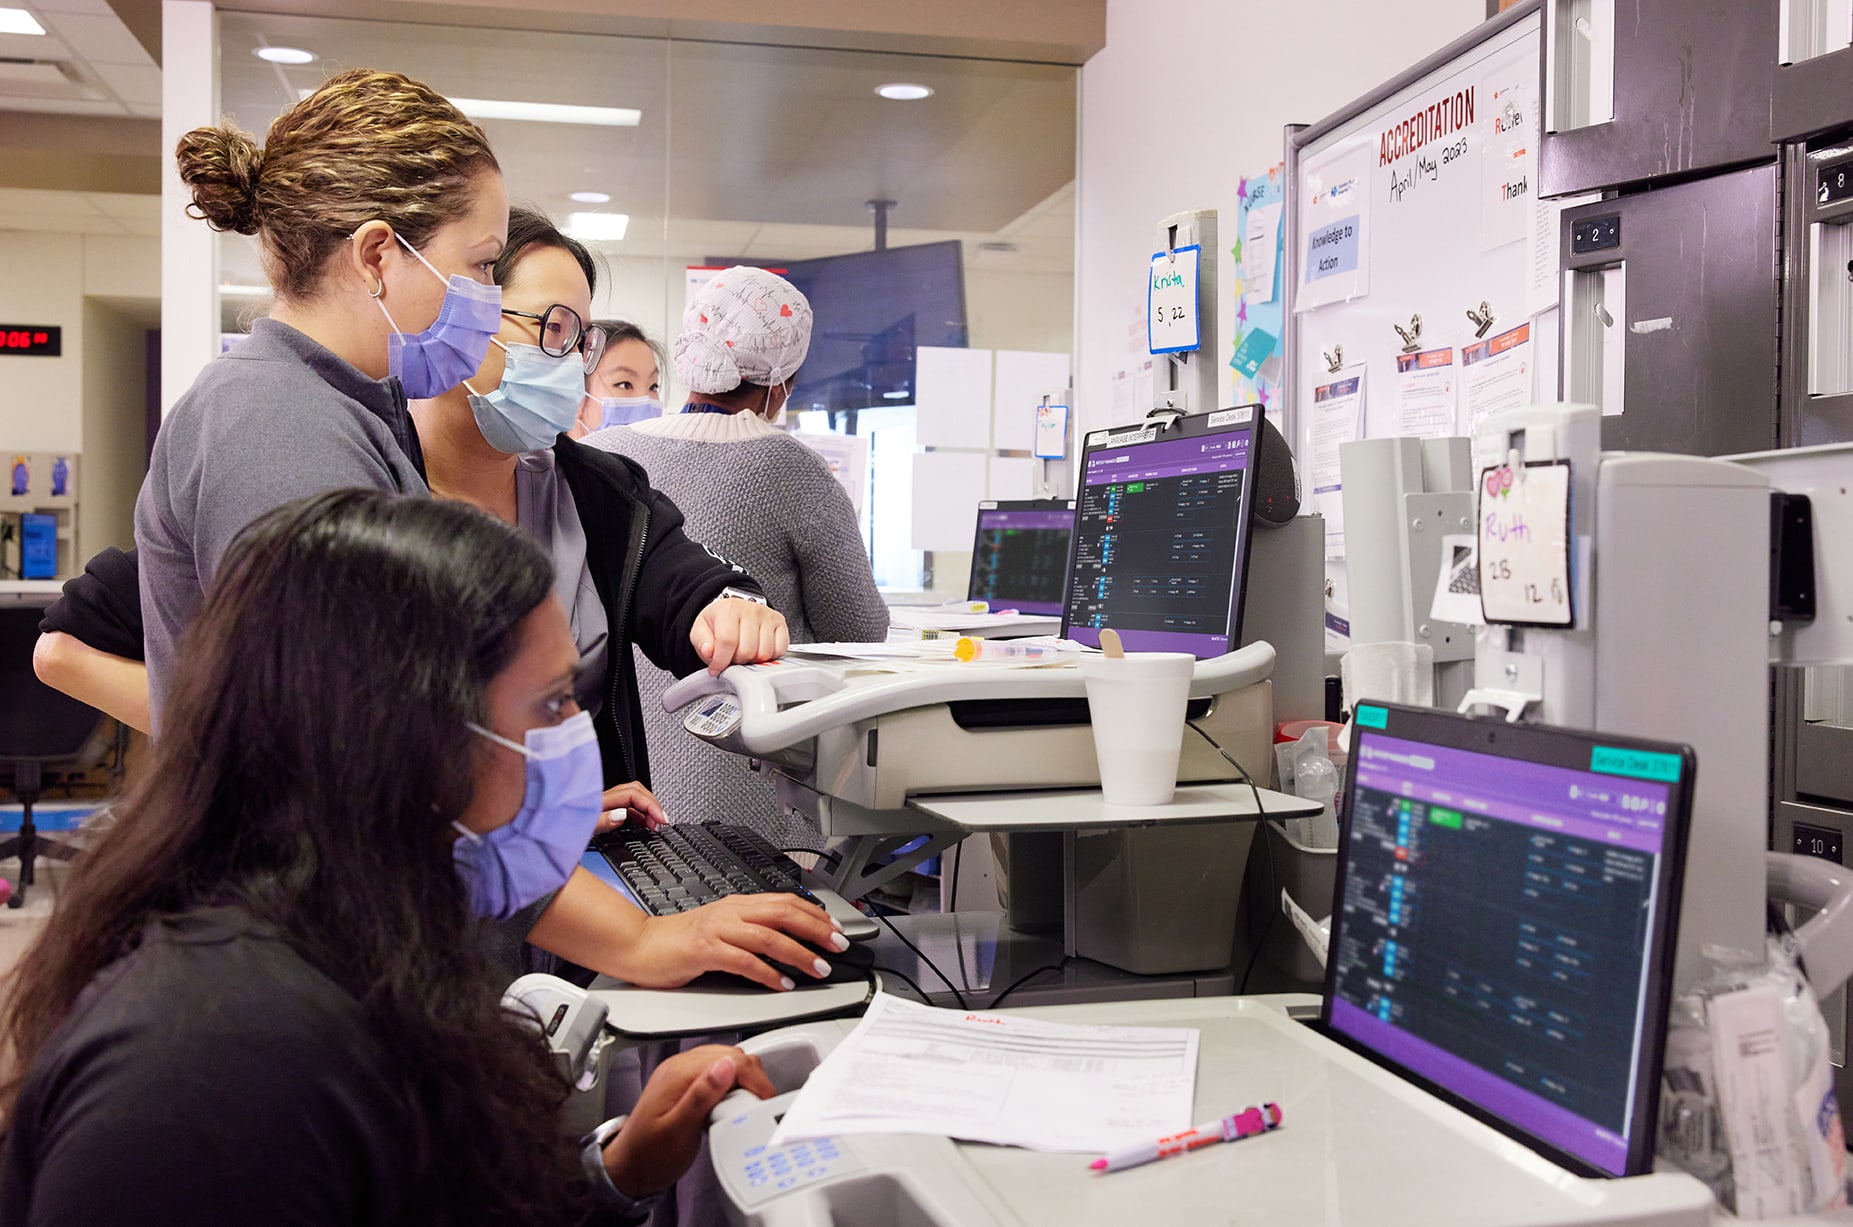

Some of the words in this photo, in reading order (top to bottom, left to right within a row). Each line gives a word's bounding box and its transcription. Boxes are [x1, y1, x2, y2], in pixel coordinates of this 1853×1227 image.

[1379, 85, 1475, 168] ACCREDITATION
[1442, 137, 1468, 165] 2023
[1502, 175, 1528, 201] Thank
[1837, 172, 1845, 188] 8
[1312, 226, 1343, 250] Knowledge
[1344, 225, 1353, 238] to
[1592, 228, 1599, 242] 2
[1318, 256, 1339, 273] Action
[1153, 270, 1185, 291] Krista
[1485, 512, 1532, 545] Ruth
[1811, 838, 1824, 854] 10
